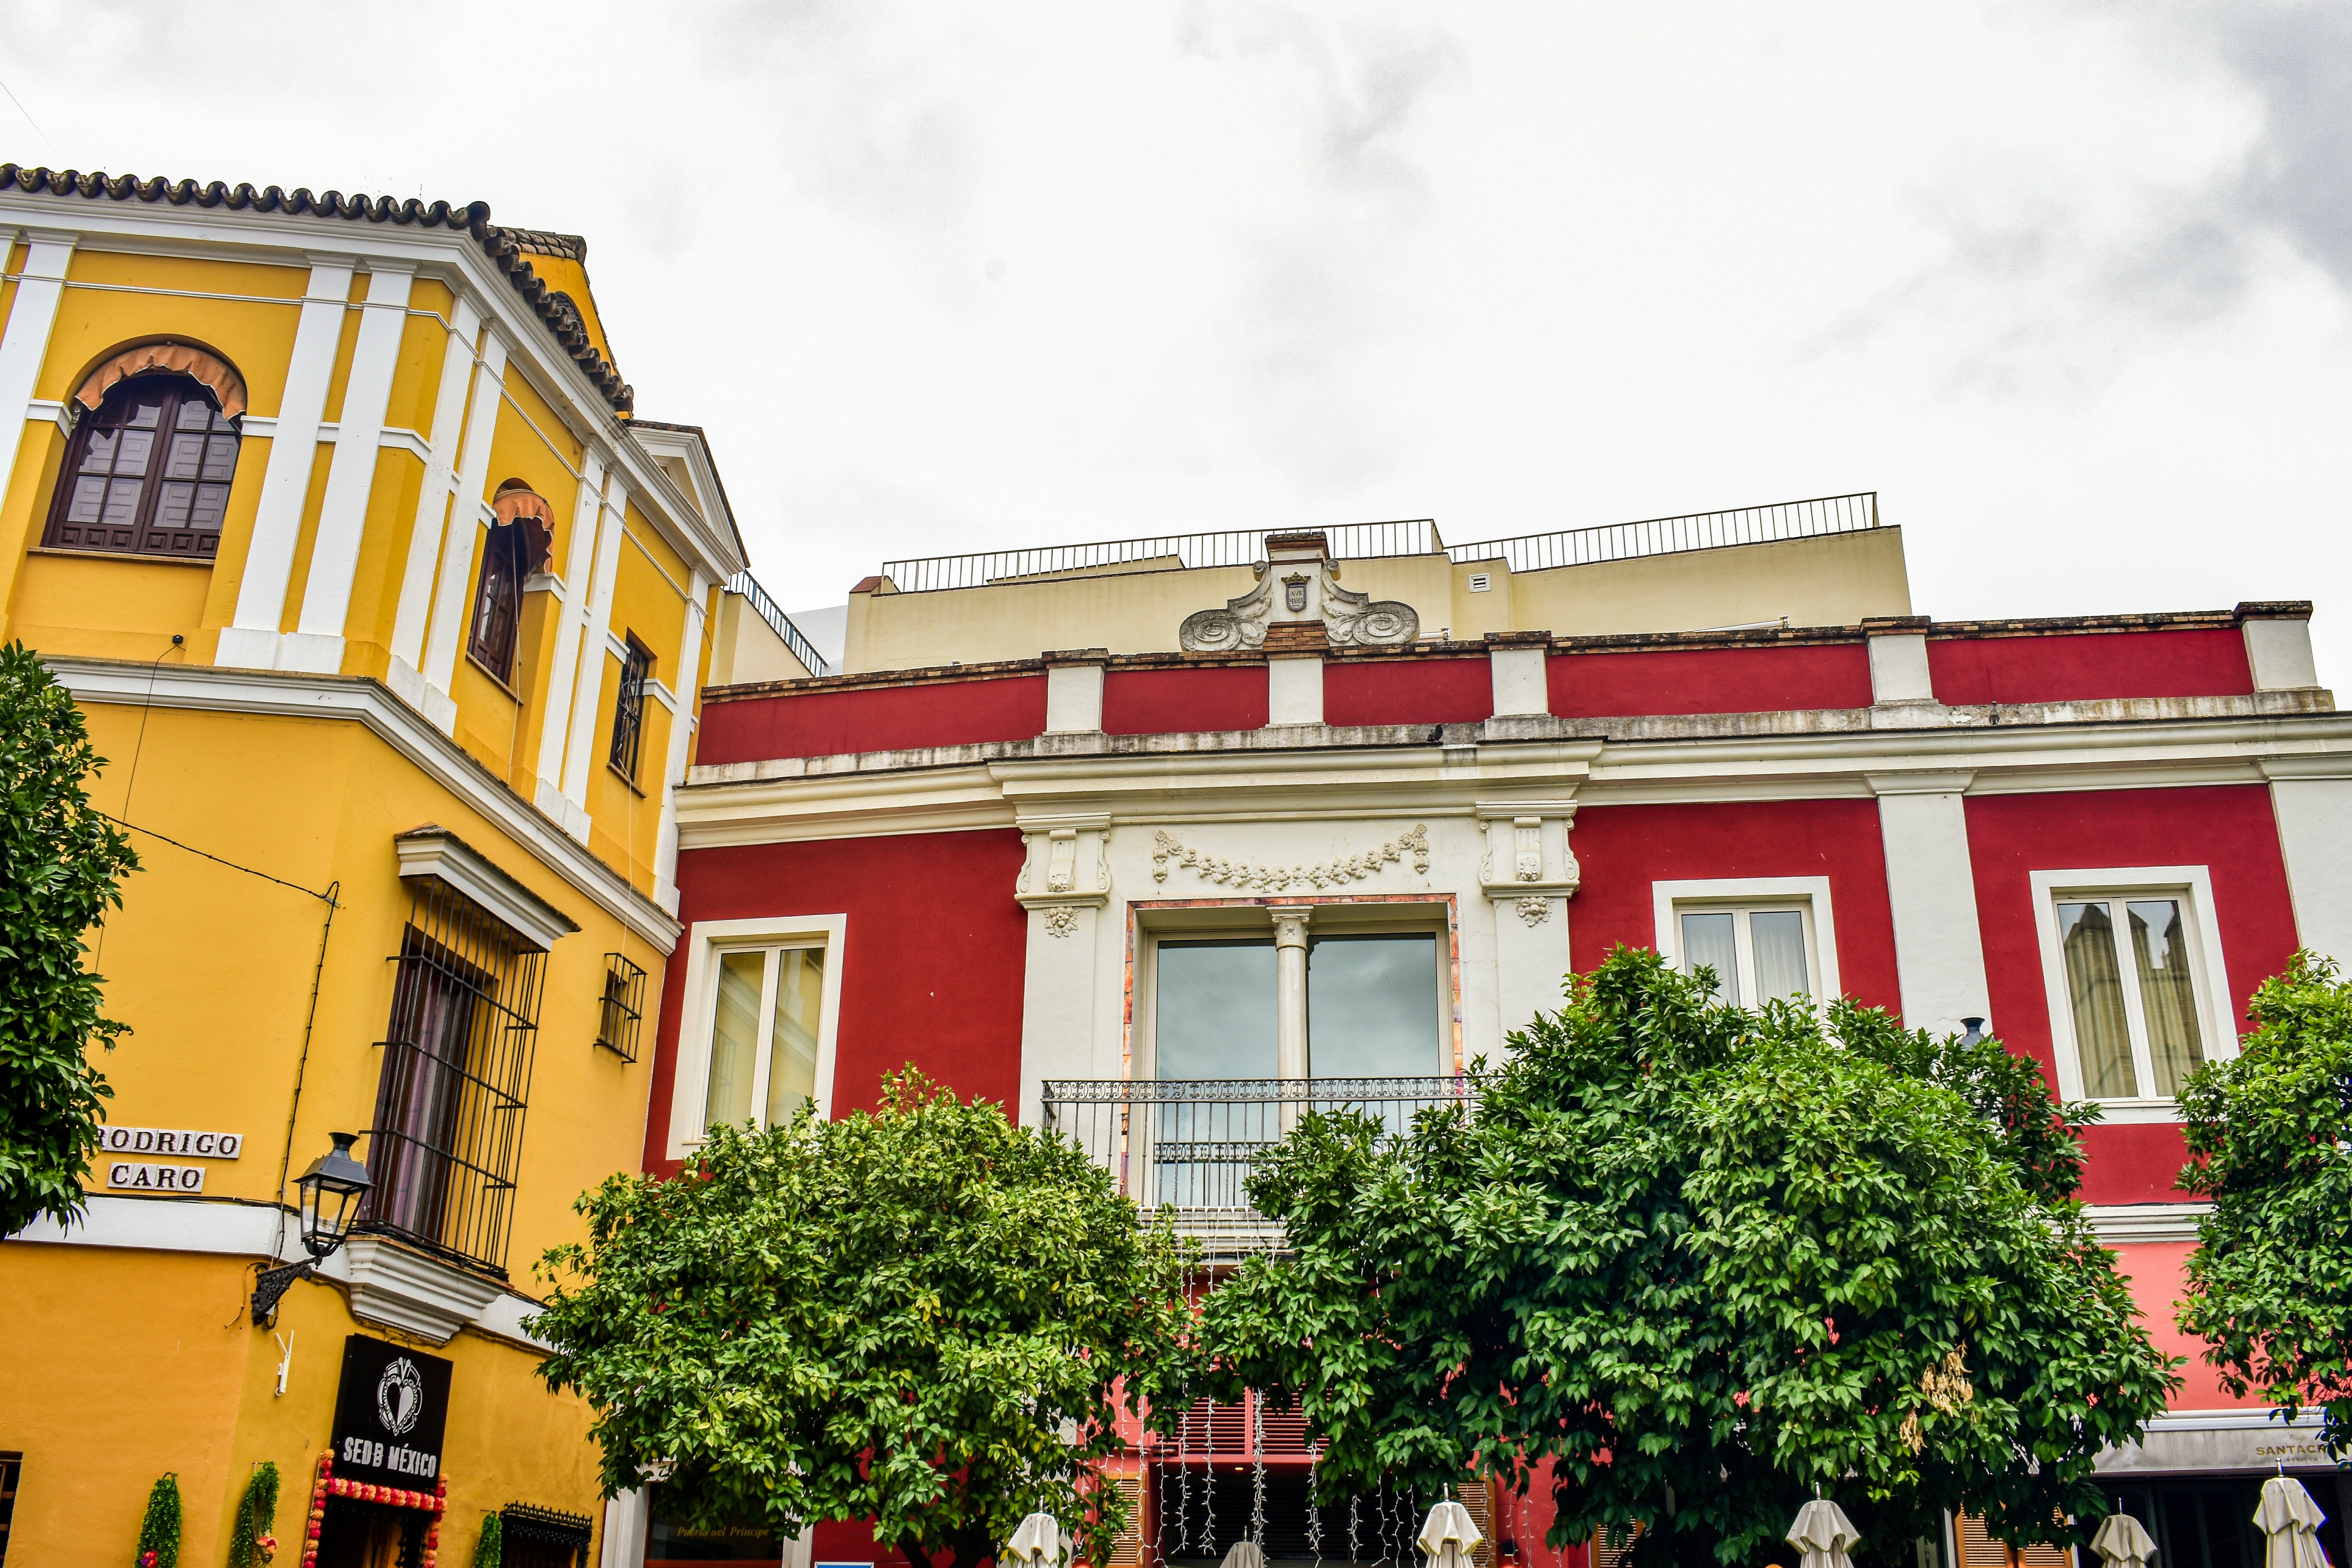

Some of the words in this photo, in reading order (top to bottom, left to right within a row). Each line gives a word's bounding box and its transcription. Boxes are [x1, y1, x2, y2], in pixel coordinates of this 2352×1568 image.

[111, 1165, 201, 1189] CARO
[2256, 1444, 2328, 1455] SANTACR
[387, 1443, 437, 1478] MÉXICO
[730, 1526, 769, 1539] Príncipe
